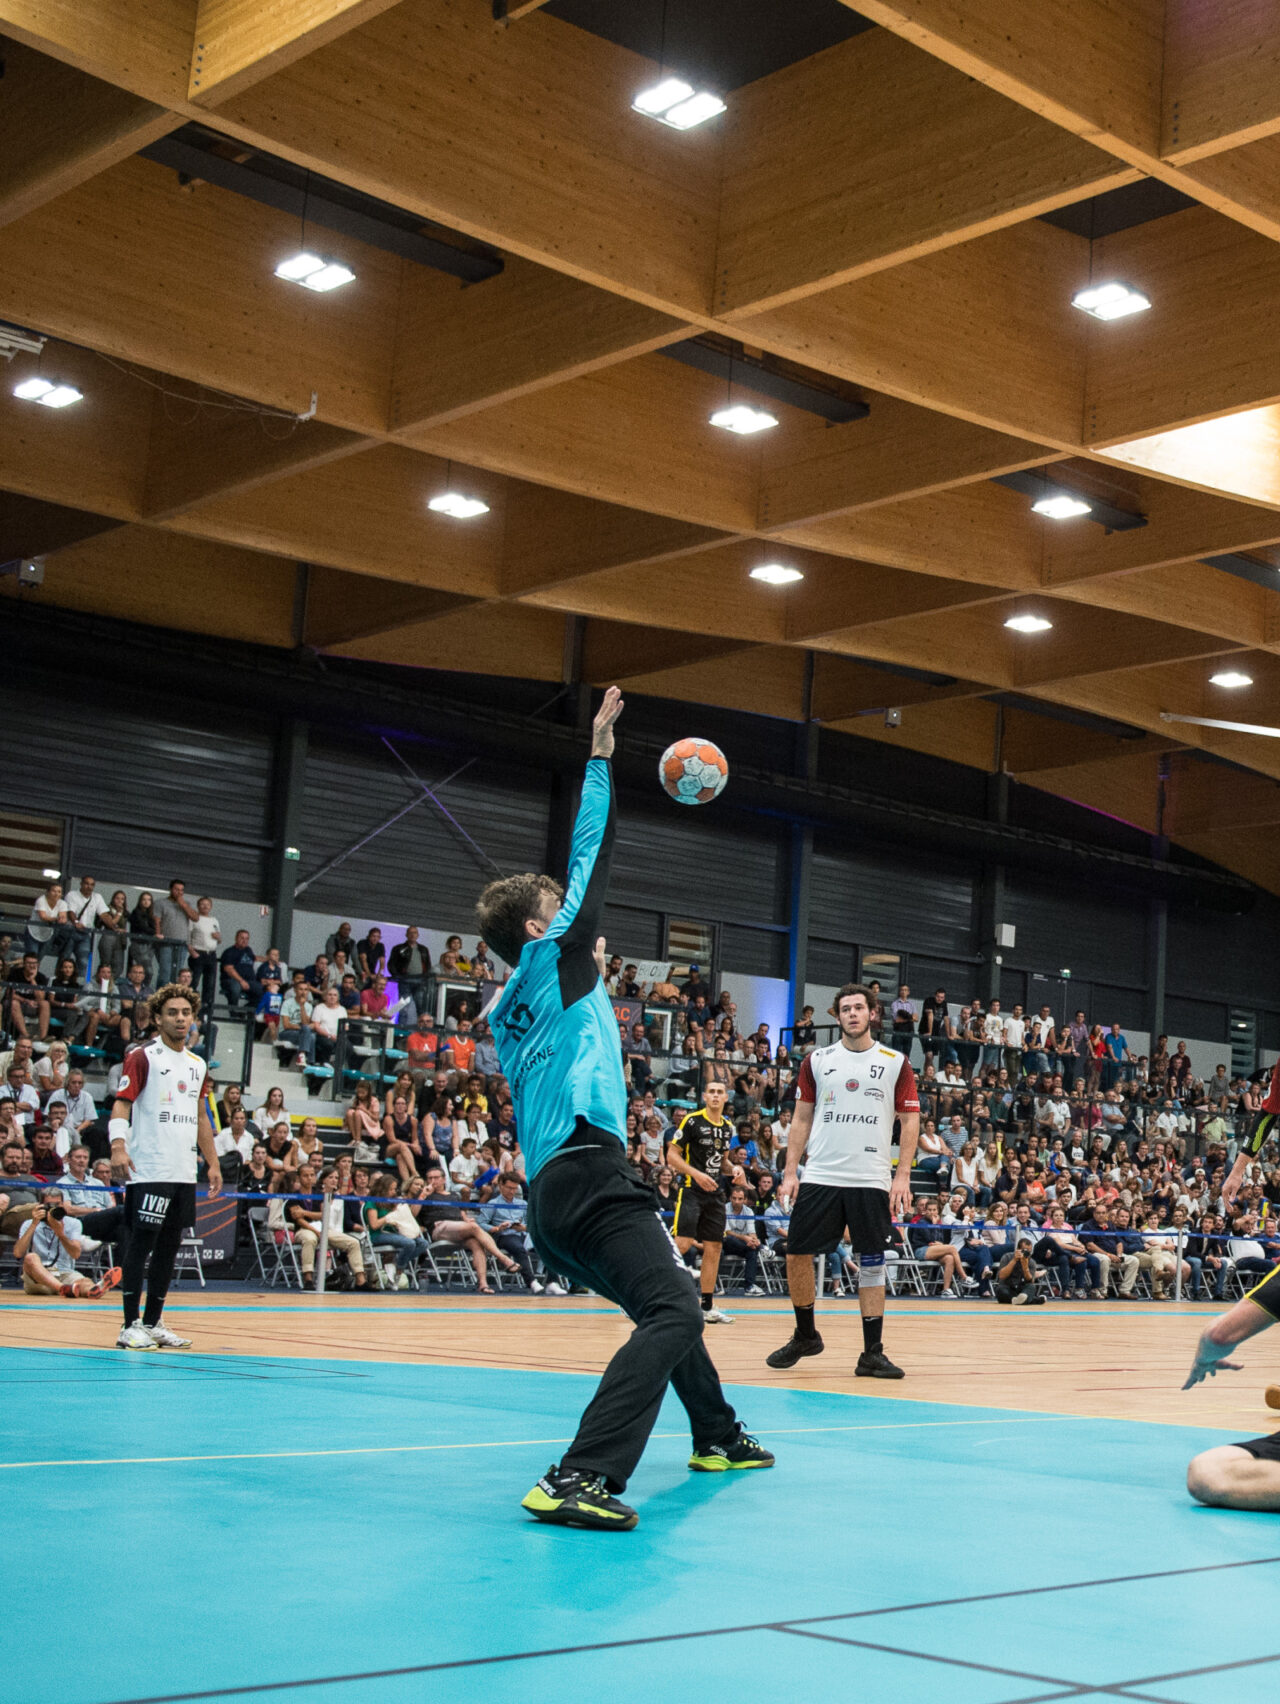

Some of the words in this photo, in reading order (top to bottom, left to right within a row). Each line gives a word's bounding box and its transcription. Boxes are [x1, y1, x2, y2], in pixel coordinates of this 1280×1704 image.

[869, 1065, 885, 1079] 57
[173, 1114, 198, 1125] EIFFAG
[835, 1113, 879, 1125] EIFFAGE
[713, 1127, 723, 1138] 11
[142, 1193, 171, 1215] IVRY
